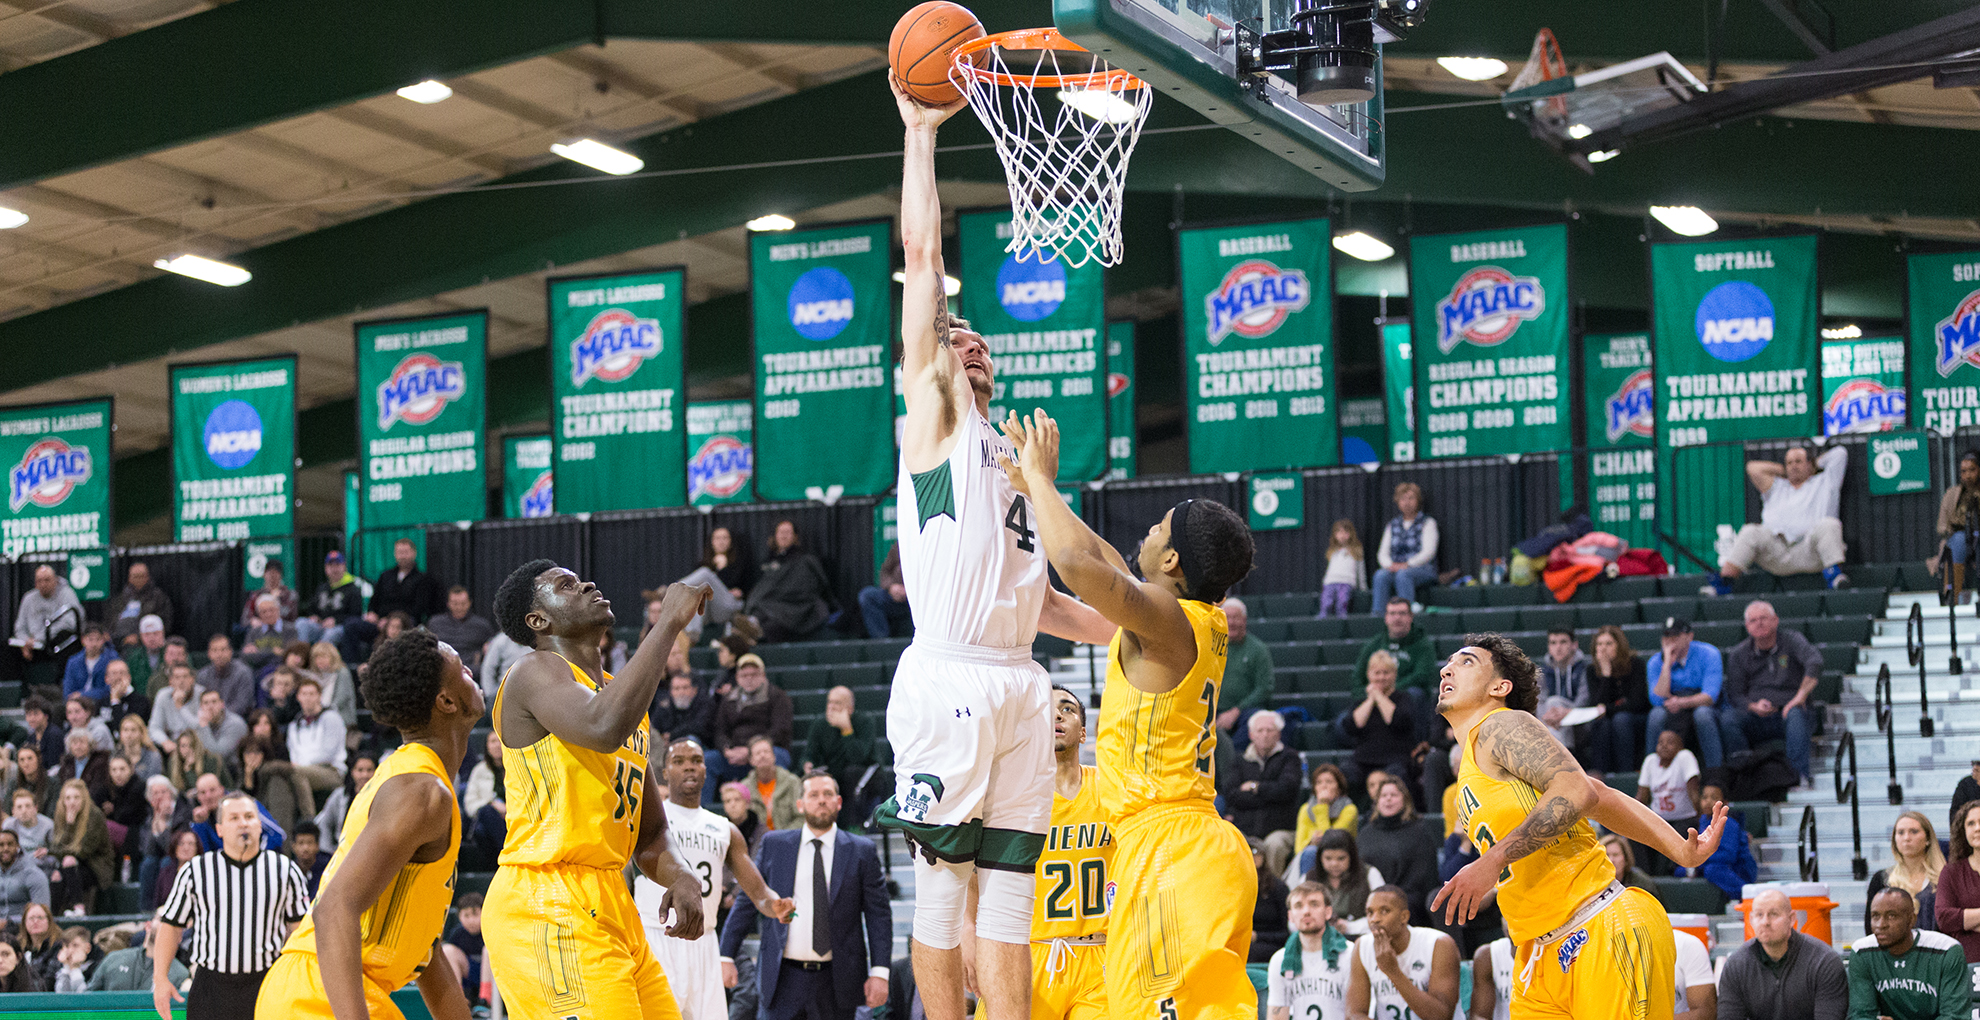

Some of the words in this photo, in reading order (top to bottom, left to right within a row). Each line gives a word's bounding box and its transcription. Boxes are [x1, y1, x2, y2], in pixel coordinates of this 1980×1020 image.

[769, 243, 809, 262] MEN'S
[810, 235, 871, 258] LACROSSE
[1219, 233, 1293, 257] BASEBALL
[1450, 239, 1527, 263] BASEBALL
[1694, 251, 1775, 272] SOFTBALL
[568, 287, 604, 307] MEN'S
[606, 283, 665, 305] LACROSSE
[1002, 280, 1066, 306] NCAA
[1208, 273, 1304, 338] MAAC
[793, 299, 855, 326] NCAA
[1441, 280, 1537, 345] MAAC
[374, 333, 411, 352] MEN'S
[412, 326, 468, 348] LACROSSE
[983, 328, 1096, 354] OURNAMENT
[1609, 336, 1648, 352] MEN'S
[1702, 317, 1774, 344] NCAA
[574, 321, 660, 380] MAAC
[763, 345, 883, 374] TOURNAMENT
[993, 350, 1096, 377] PEARANCES
[1196, 344, 1324, 374] TOURNAMENT
[179, 374, 232, 394] WOMEN'S
[232, 369, 288, 391] LACROSSE
[764, 367, 884, 396] APPEARANCES
[1428, 359, 1496, 382] REGULAR
[1498, 354, 1556, 377] SEASON
[380, 363, 463, 425] MAAC
[1198, 366, 1323, 398] CHAMPIONS
[1429, 374, 1558, 408] CHAMPIONS
[1667, 369, 1807, 397] TOURNAMENT
[561, 389, 674, 415] TOURNAMENT
[1667, 392, 1808, 422] APPEARANCES
[52, 412, 103, 433] LACROSSE
[562, 408, 673, 439] CHAMPIONS
[208, 429, 262, 455] NCAA
[370, 435, 425, 456] REGULAR
[427, 431, 475, 451] SEASON
[1872, 436, 1918, 453] Section
[12, 449, 88, 505] MAAC
[369, 448, 476, 480] CHAMPIONS
[180, 473, 287, 500] TOURNAMENT
[1252, 477, 1295, 491] Section
[180, 494, 287, 521] APPEARANCES
[1, 512, 100, 539] TOURNAMENT
[1005, 494, 1035, 553] 4
[2, 531, 100, 556] CHAMPIONS
[1194, 677, 1217, 778] 2
[676, 830, 724, 859] NHATTAN
[1048, 823, 1112, 851] IENA
[1043, 857, 1107, 922] 20
[1557, 928, 1590, 974] MAAC
[1875, 977, 1937, 998] MANHATTAN
